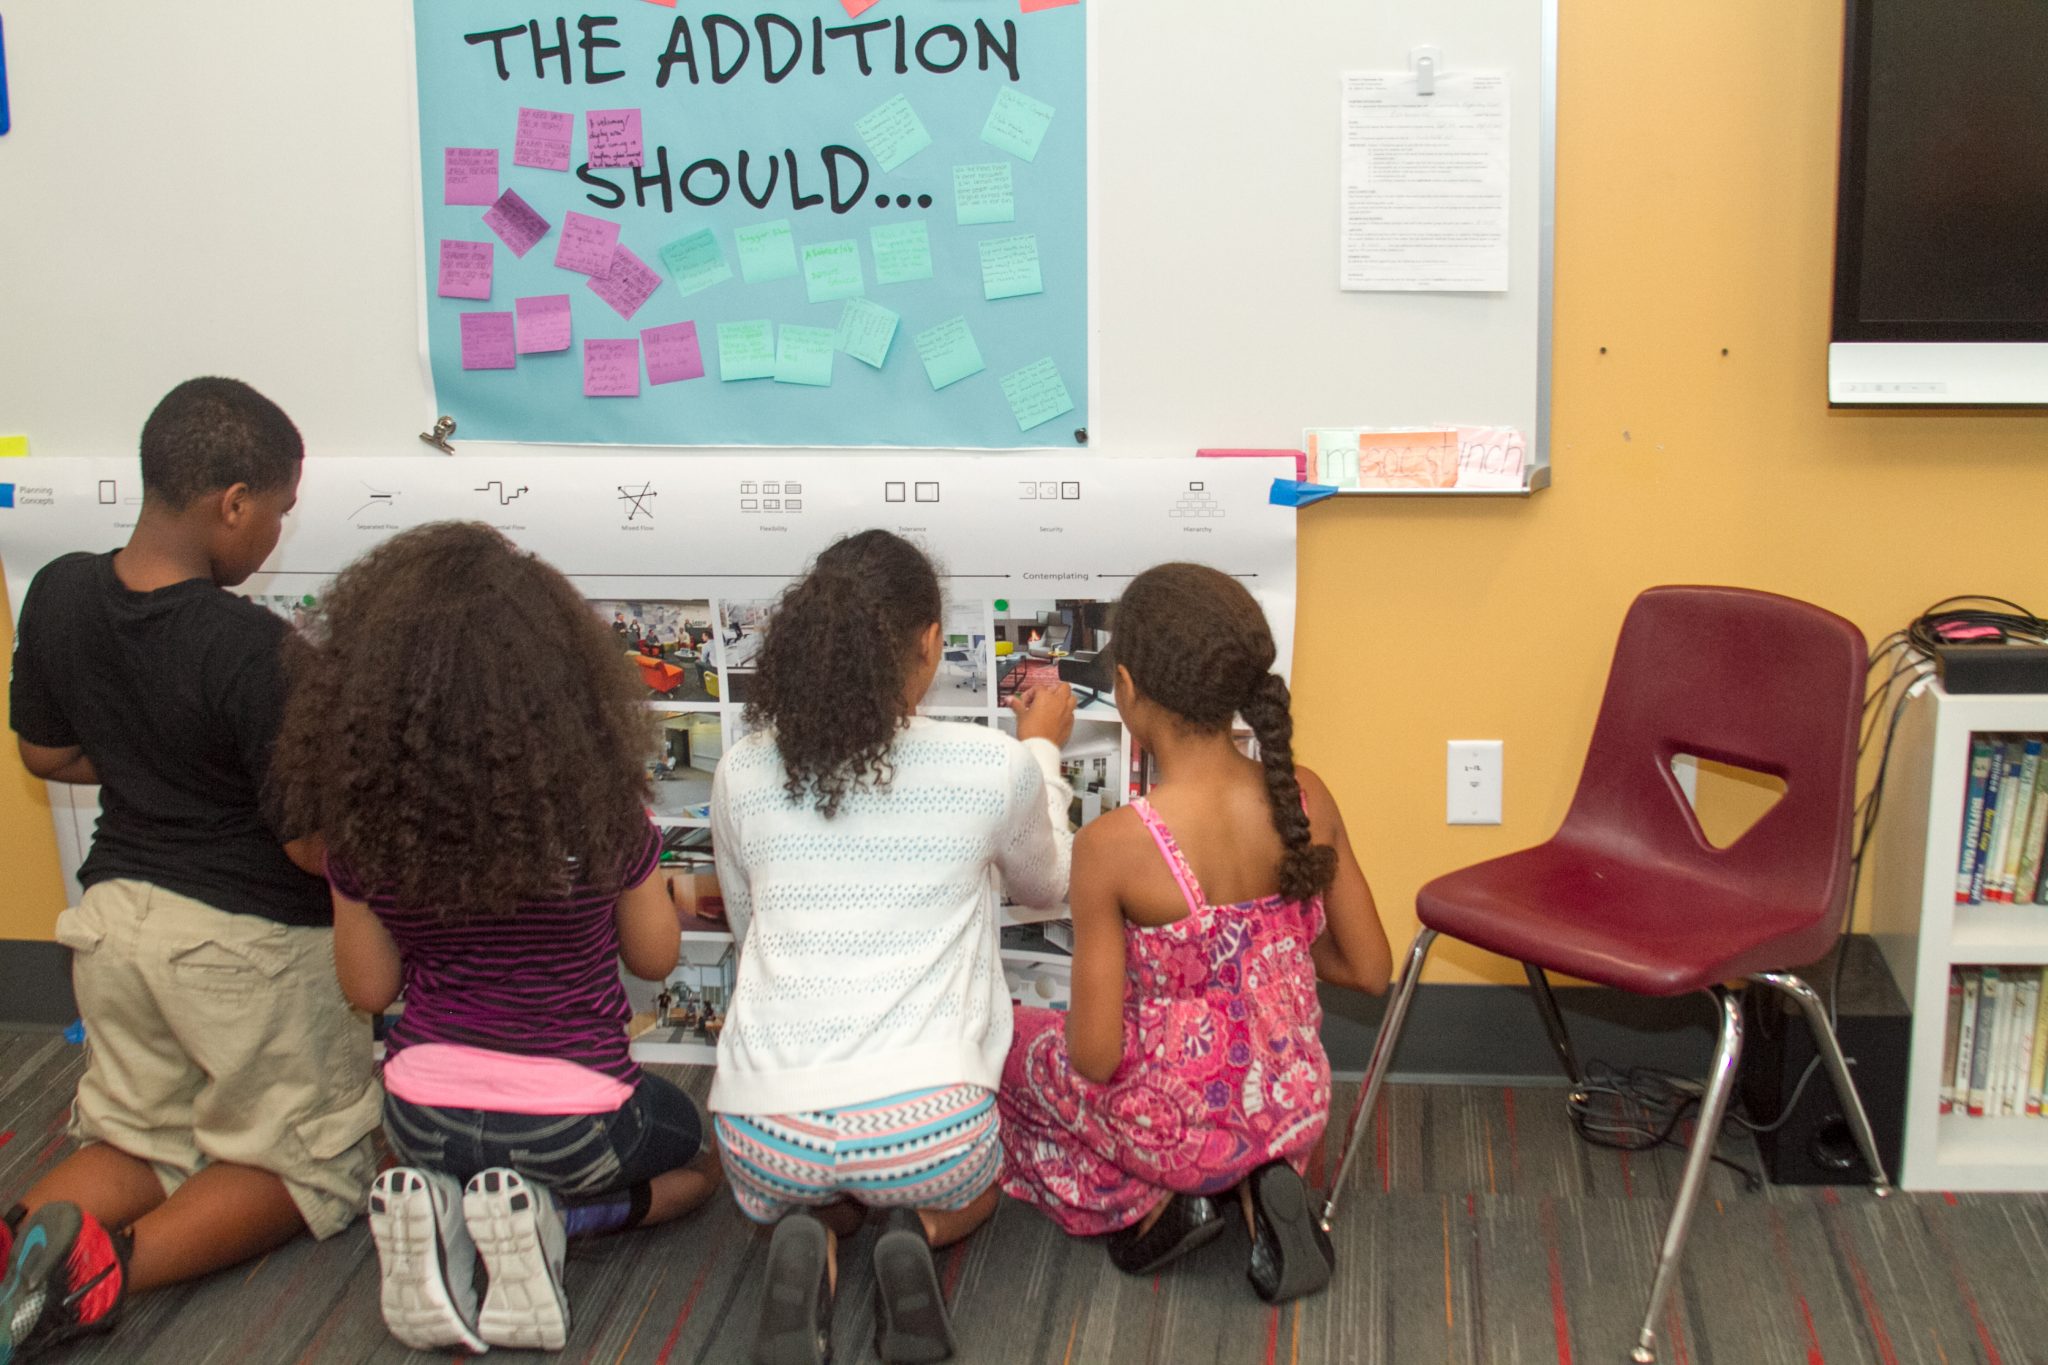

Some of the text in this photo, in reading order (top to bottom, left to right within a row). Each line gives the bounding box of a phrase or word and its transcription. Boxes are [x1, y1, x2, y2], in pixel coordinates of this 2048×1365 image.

[464, 13, 1020, 88] THE ADDITION
[577, 145, 932, 213] SHOULD...
[19, 486, 53, 497] Planning
[19, 497, 54, 507] Concepts
[621, 524, 638, 532] Mixed
[759, 525, 788, 533] Flexibility
[1039, 526, 1064, 534] Security
[1022, 572, 1089, 582] Contemplating
